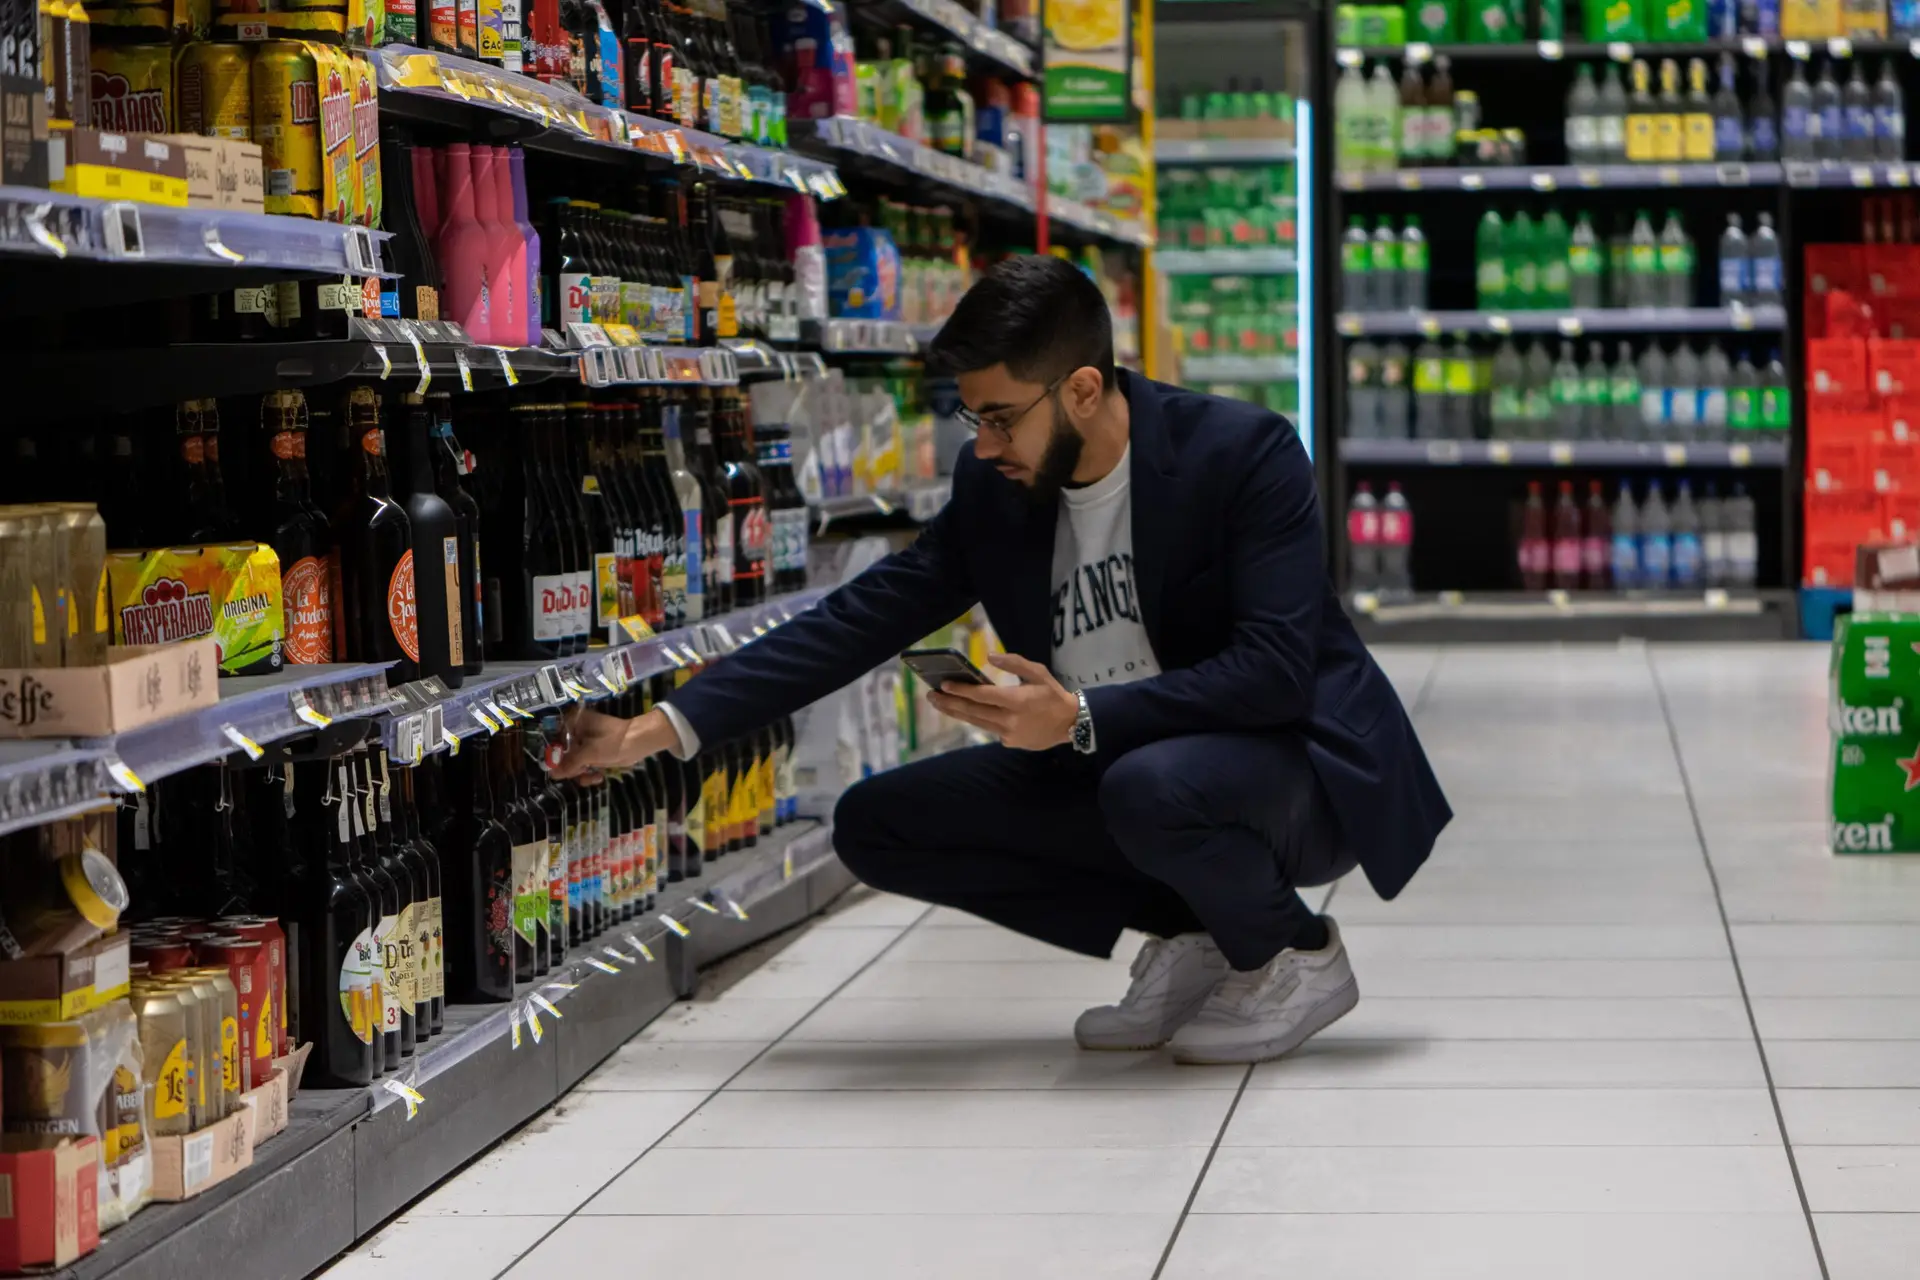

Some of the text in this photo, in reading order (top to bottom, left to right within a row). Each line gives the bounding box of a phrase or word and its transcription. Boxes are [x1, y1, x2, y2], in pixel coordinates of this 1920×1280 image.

[223, 593, 271, 620] ORIGINAL
[124, 594, 214, 647] DESPERADOS
[387, 1007, 396, 1025] 3
